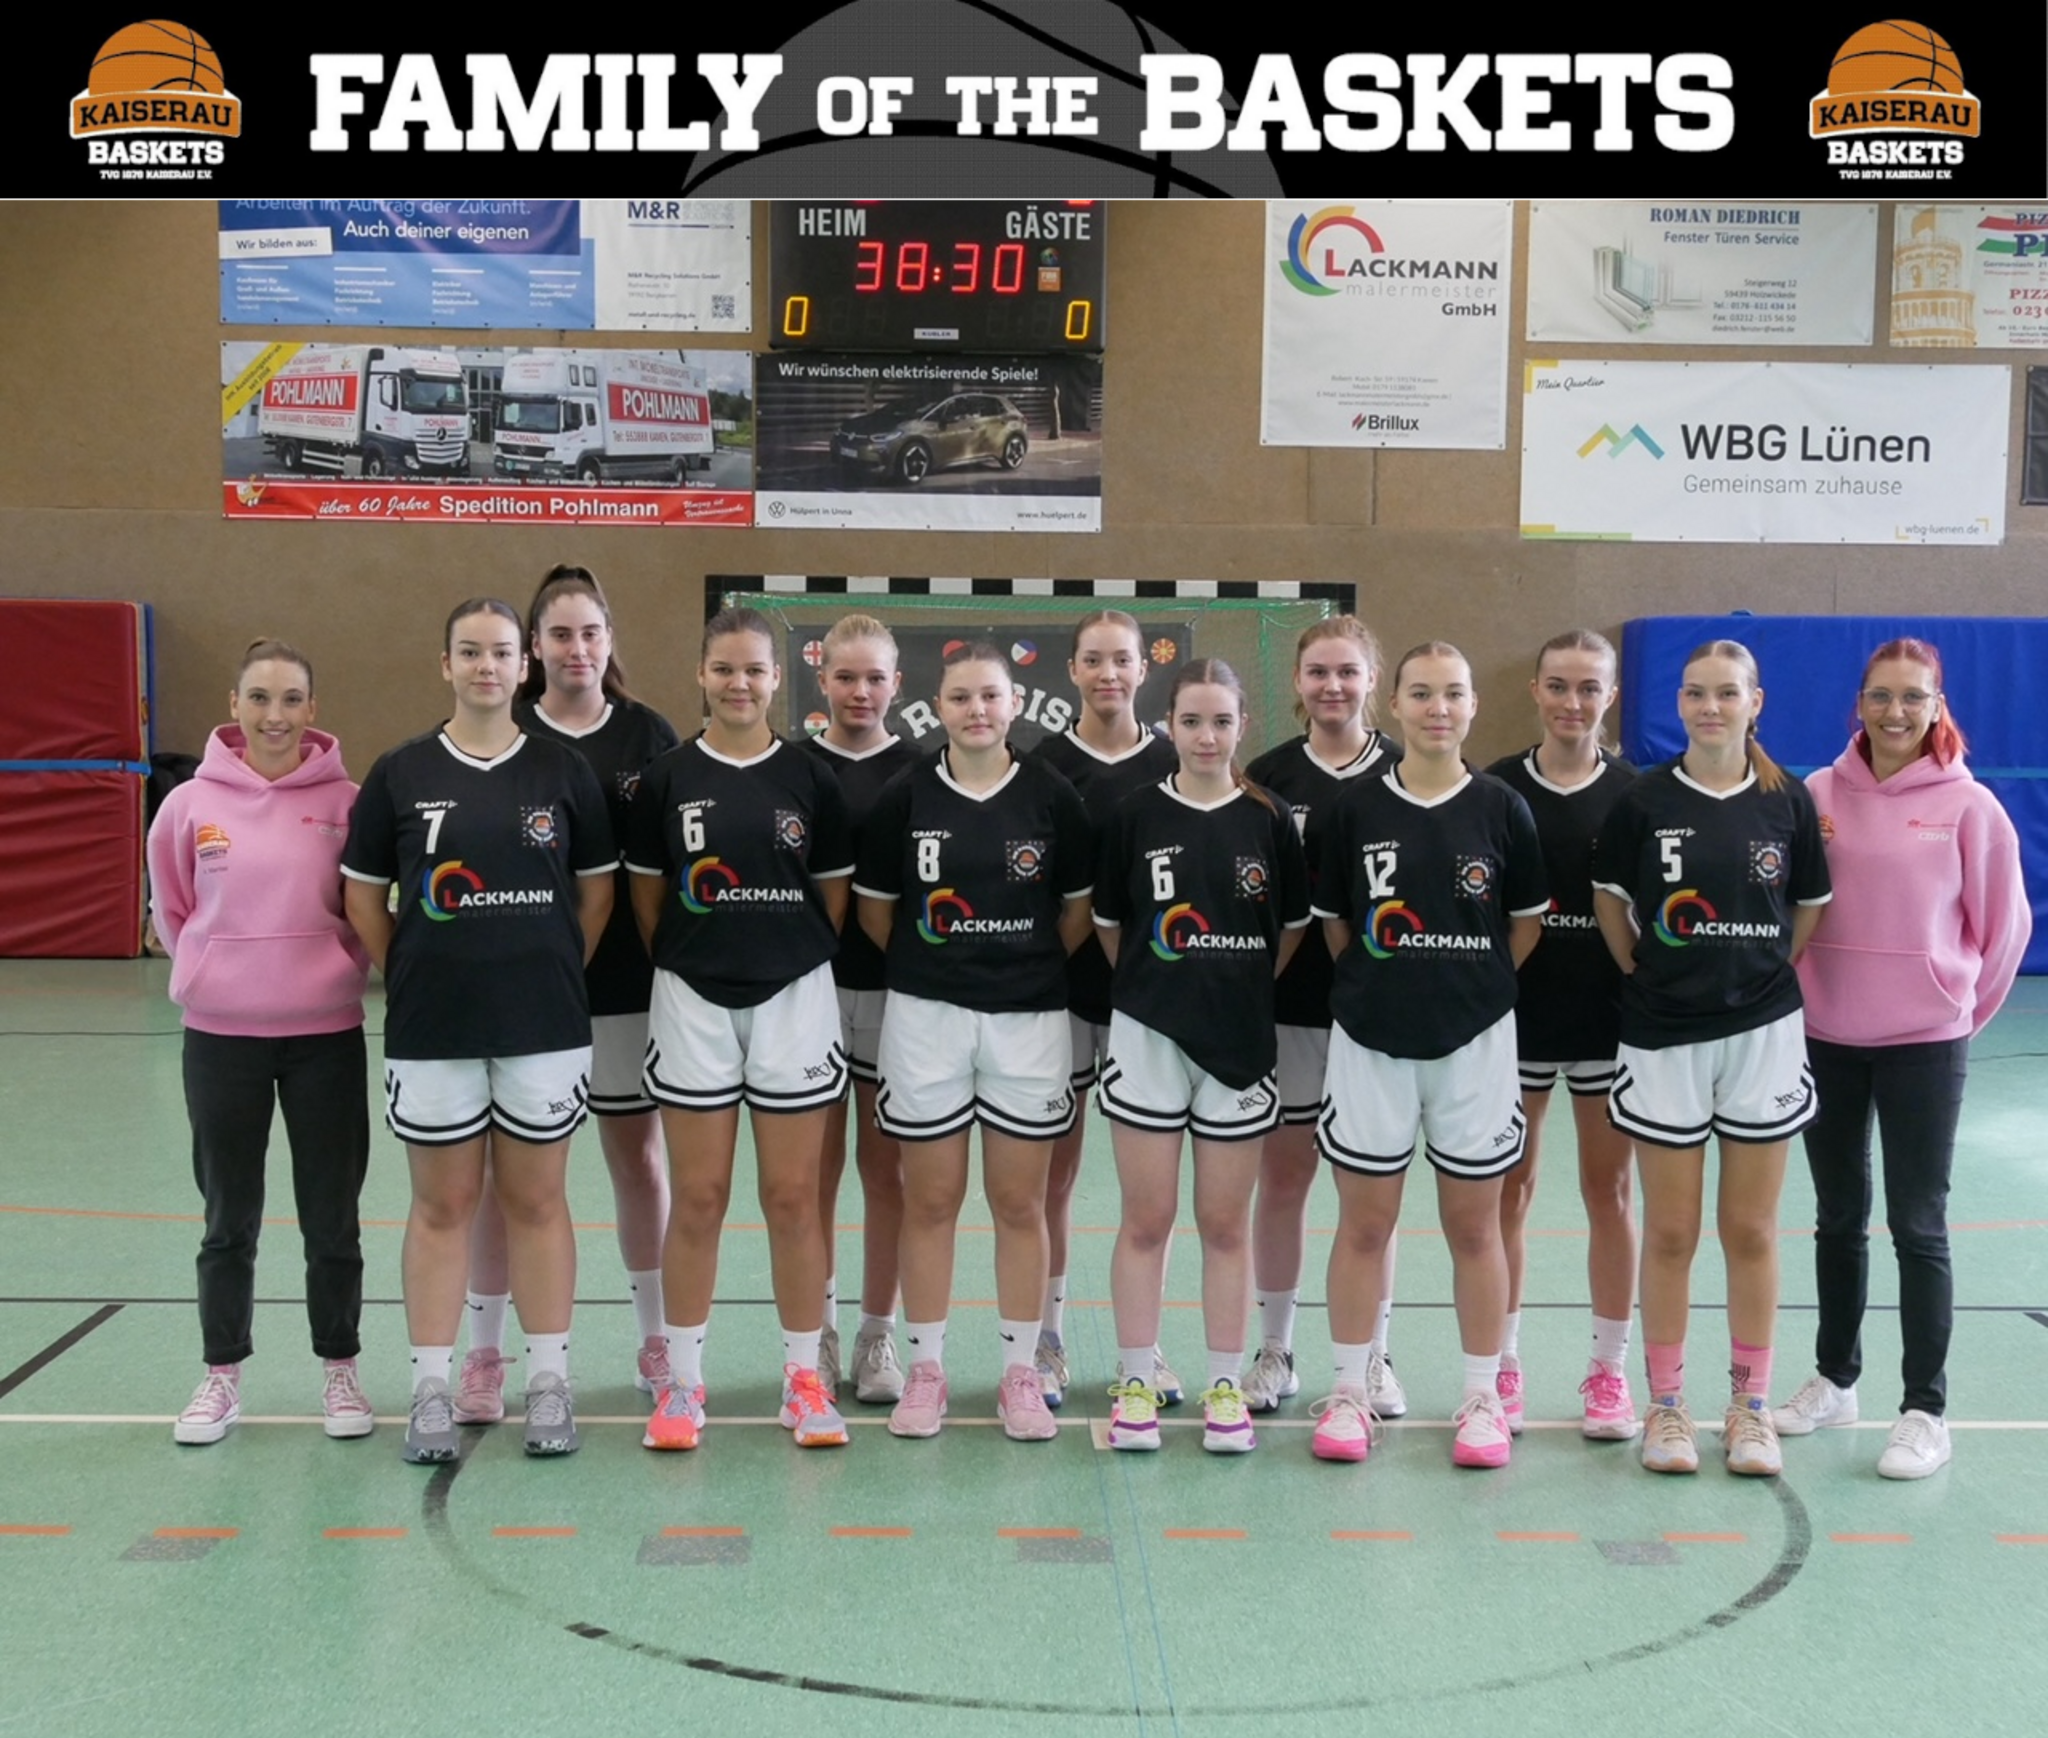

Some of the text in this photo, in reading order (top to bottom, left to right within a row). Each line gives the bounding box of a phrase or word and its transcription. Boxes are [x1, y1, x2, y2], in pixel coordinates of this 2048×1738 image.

[235, 199, 532, 218] Arbeiten im Auftrag der Zukunft.
[627, 201, 681, 220] M&R
[1649, 208, 1800, 225] ROMAN DIEDRICH
[343, 220, 530, 244] Auch deiner eigenen
[798, 205, 1092, 241] HEIM GÄSTE
[236, 239, 317, 250] Wir bilden aus:
[1663, 230, 1800, 245] Fenster Türen Service
[855, 242, 1024, 293] 38:30
[1324, 248, 1498, 280] LACKMANN
[1346, 282, 1498, 299] malermeister
[1750, 291, 1797, 299] Holzwickede
[783, 296, 808, 336] 0
[1065, 300, 1090, 339] 0
[1441, 303, 1497, 317] GmbH
[778, 362, 1040, 383] Wir wünschen elektrisierende Spiele!
[270, 378, 345, 407] POHLMANN
[1563, 376, 1606, 392] Quartier
[622, 388, 700, 422] POHLMANN
[1368, 414, 1420, 431] Brillux
[1680, 422, 1931, 462] WBG Lünen
[1682, 473, 1903, 495] Gemeinsam zuhause
[319, 496, 659, 520] über 60 Jahre Spedition Pohlmann
[789, 506, 1087, 521] Hülpert in Unna www.huelpert.de
[415, 801, 448, 809] CRAFT
[678, 800, 707, 812] CRAFT
[422, 809, 446, 855] 7
[682, 808, 706, 853] 6
[912, 831, 943, 839] CRAFT
[1654, 829, 1686, 838] CRAFT
[1145, 846, 1174, 859] CRAFT
[1363, 841, 1391, 852] CRAFT
[918, 838, 940, 883] 8
[1661, 837, 1682, 883] 5
[1151, 855, 1176, 902] 6
[1363, 850, 1397, 900] 12
[444, 888, 554, 909] LACKMANN
[701, 882, 804, 902] LACKMANN
[936, 914, 1035, 933] LACKMANN
[1677, 916, 1780, 937] LACKMANN
[1383, 926, 1492, 949] LACKMANN
